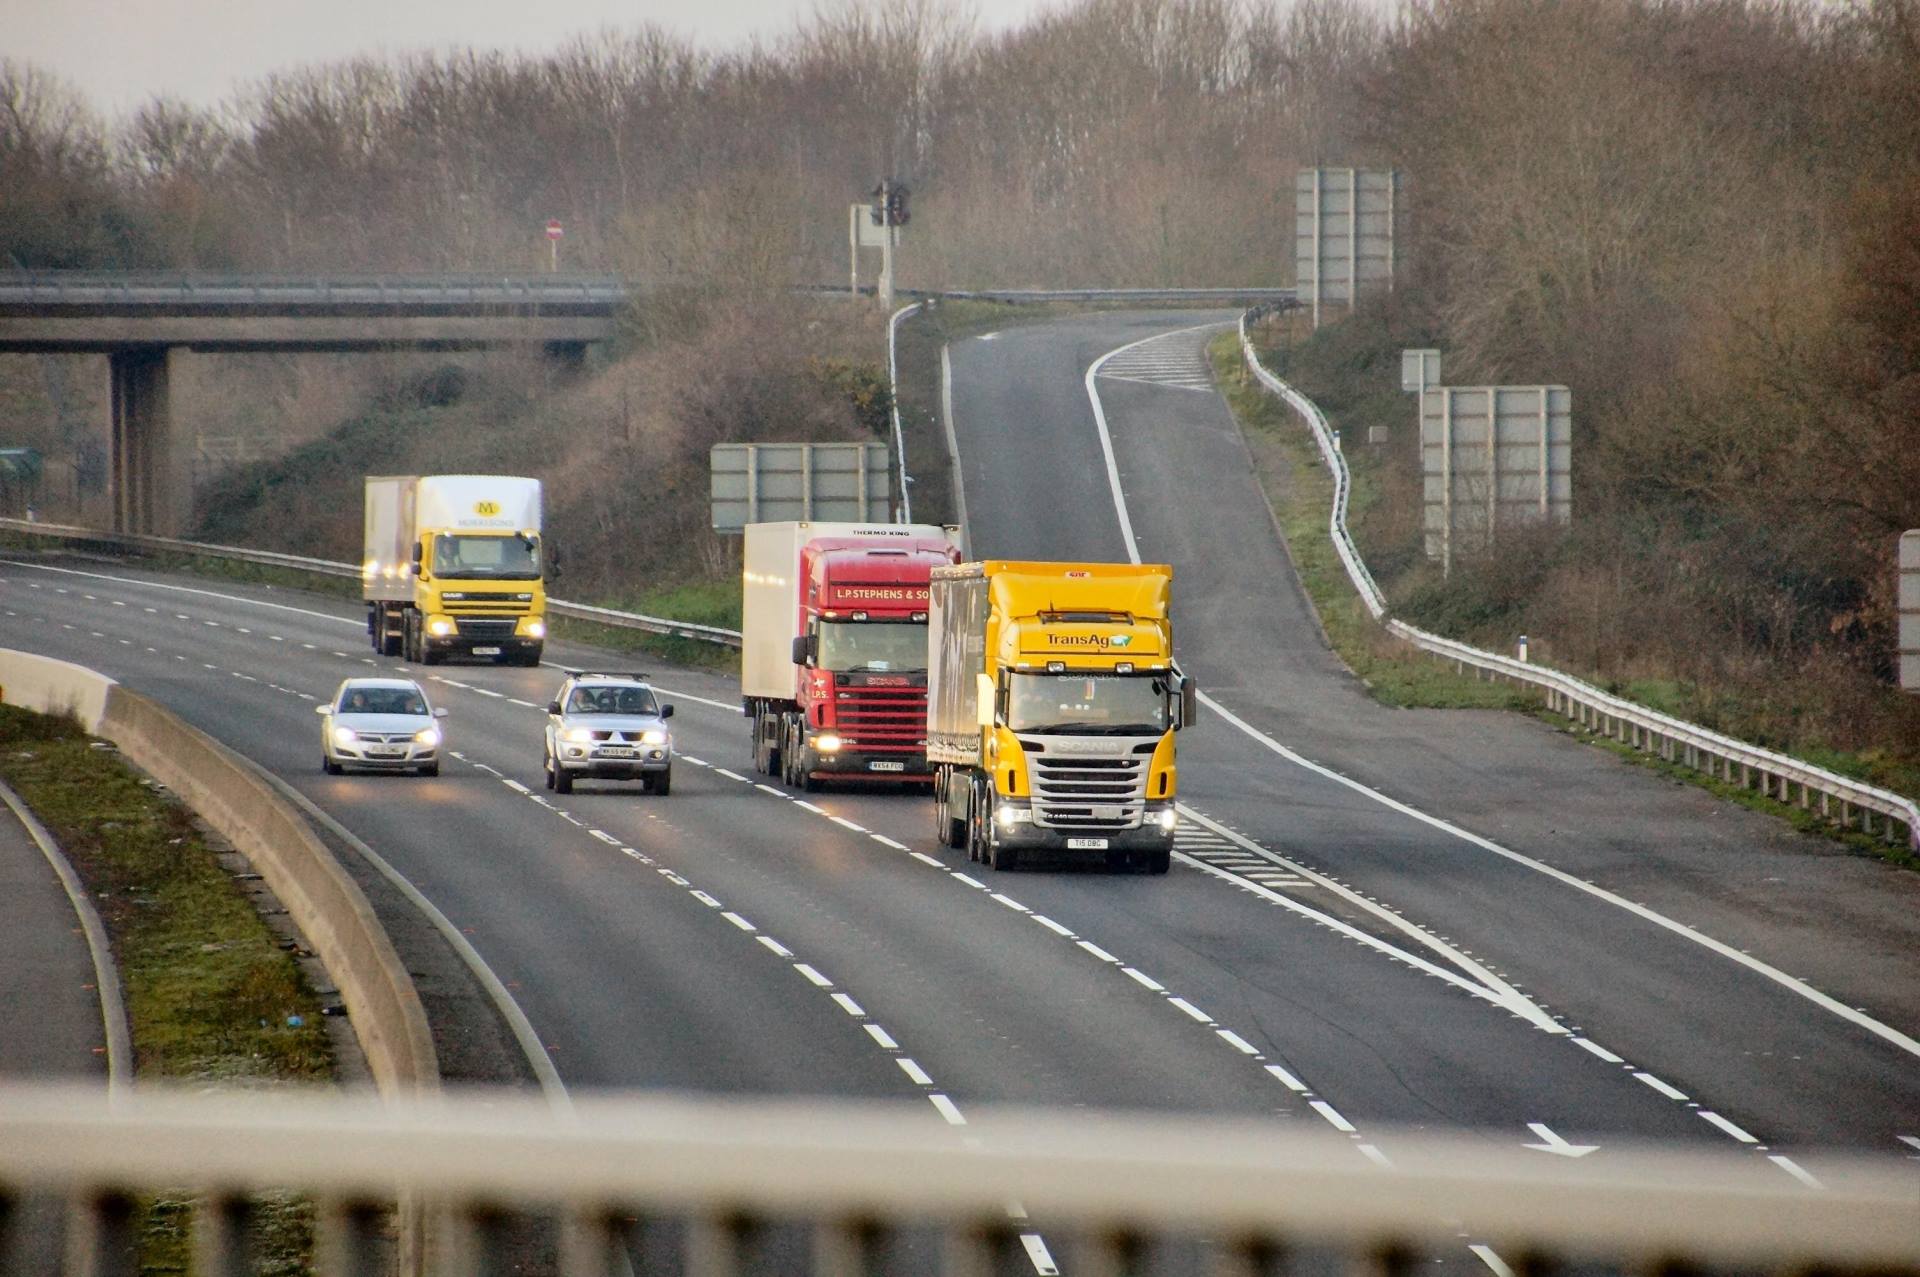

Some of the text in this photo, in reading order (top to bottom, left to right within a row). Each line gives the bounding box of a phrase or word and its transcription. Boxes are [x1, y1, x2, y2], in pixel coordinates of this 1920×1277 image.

[478, 502, 495, 513] M
[853, 590, 902, 599] STEPHENS
[906, 591, 913, 599] &
[916, 591, 929, 600] SO
[1048, 633, 1109, 648] TransAg
